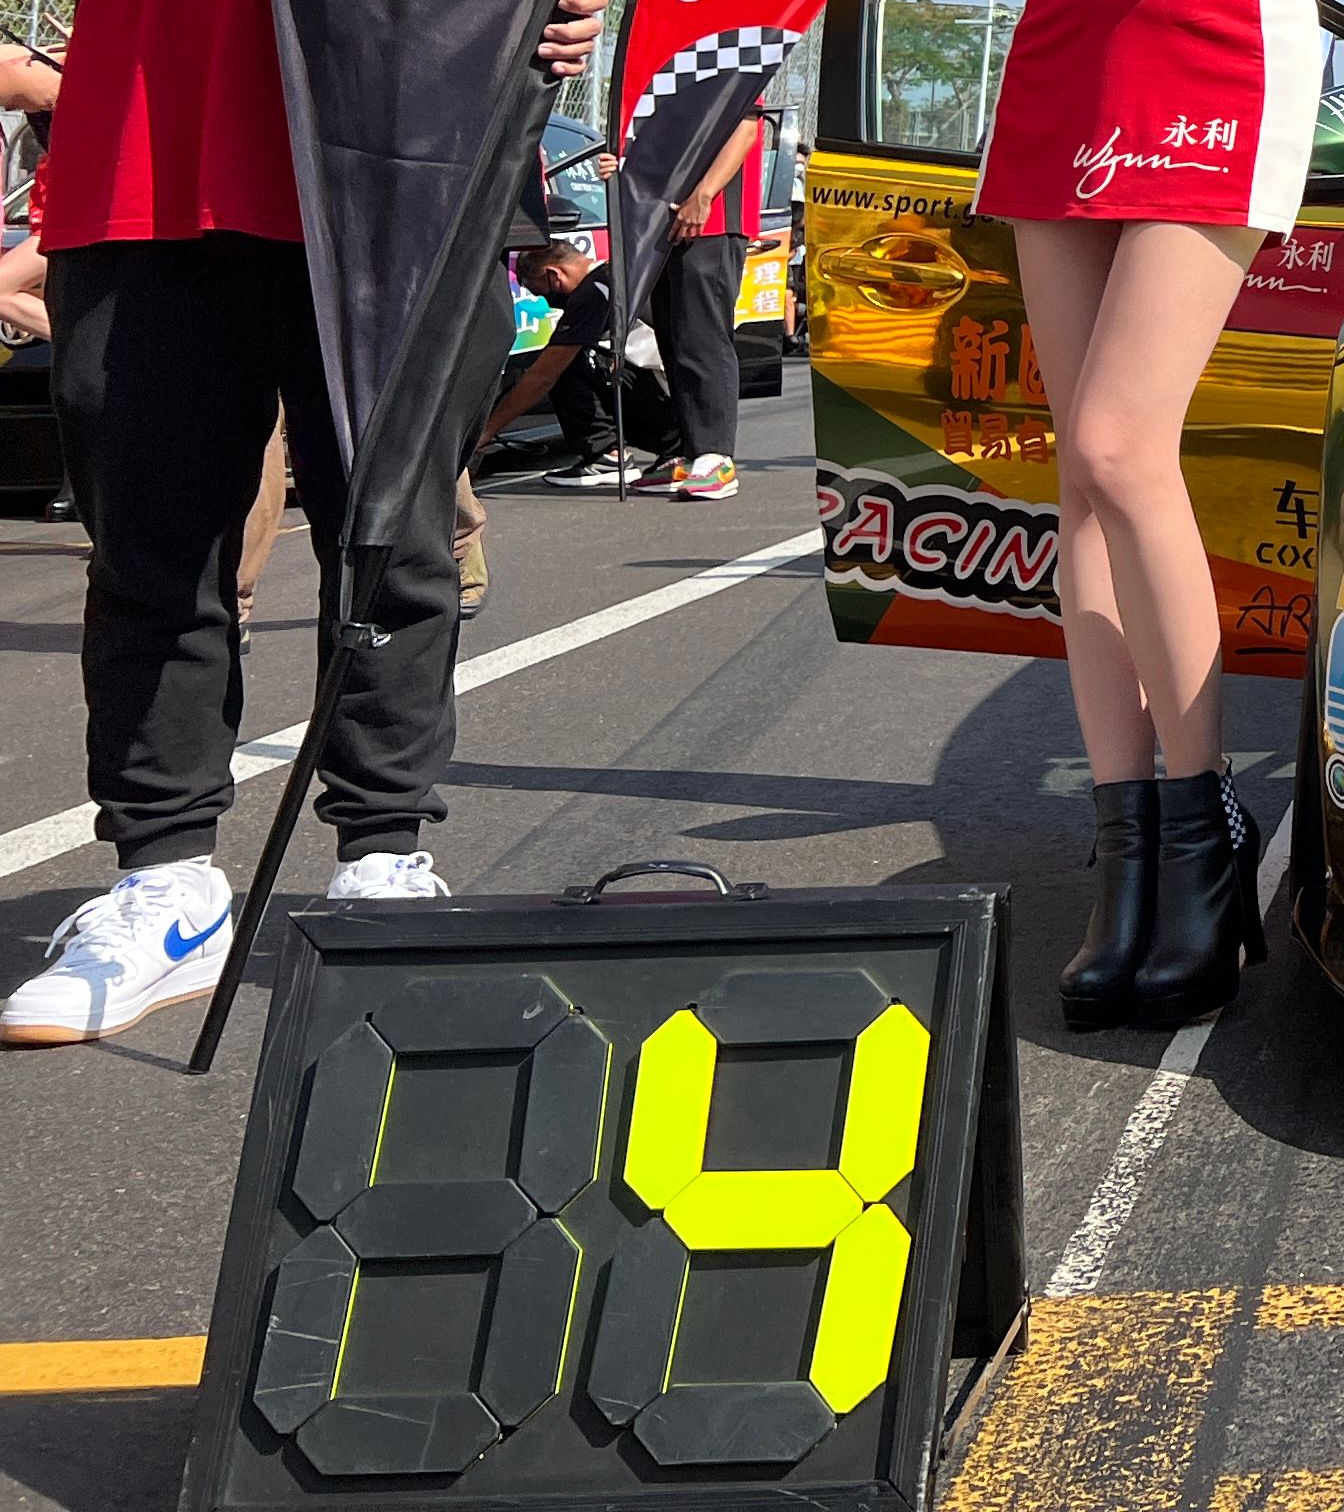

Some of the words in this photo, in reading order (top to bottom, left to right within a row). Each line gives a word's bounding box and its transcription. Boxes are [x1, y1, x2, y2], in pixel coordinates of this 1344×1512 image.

[1159, 115, 1238, 153] 永利
[812, 186, 1007, 228] www.sport.g
[1278, 238, 1336, 273] 永利
[818, 490, 1060, 595] ACIN
[624, 1002, 930, 1414] 4
